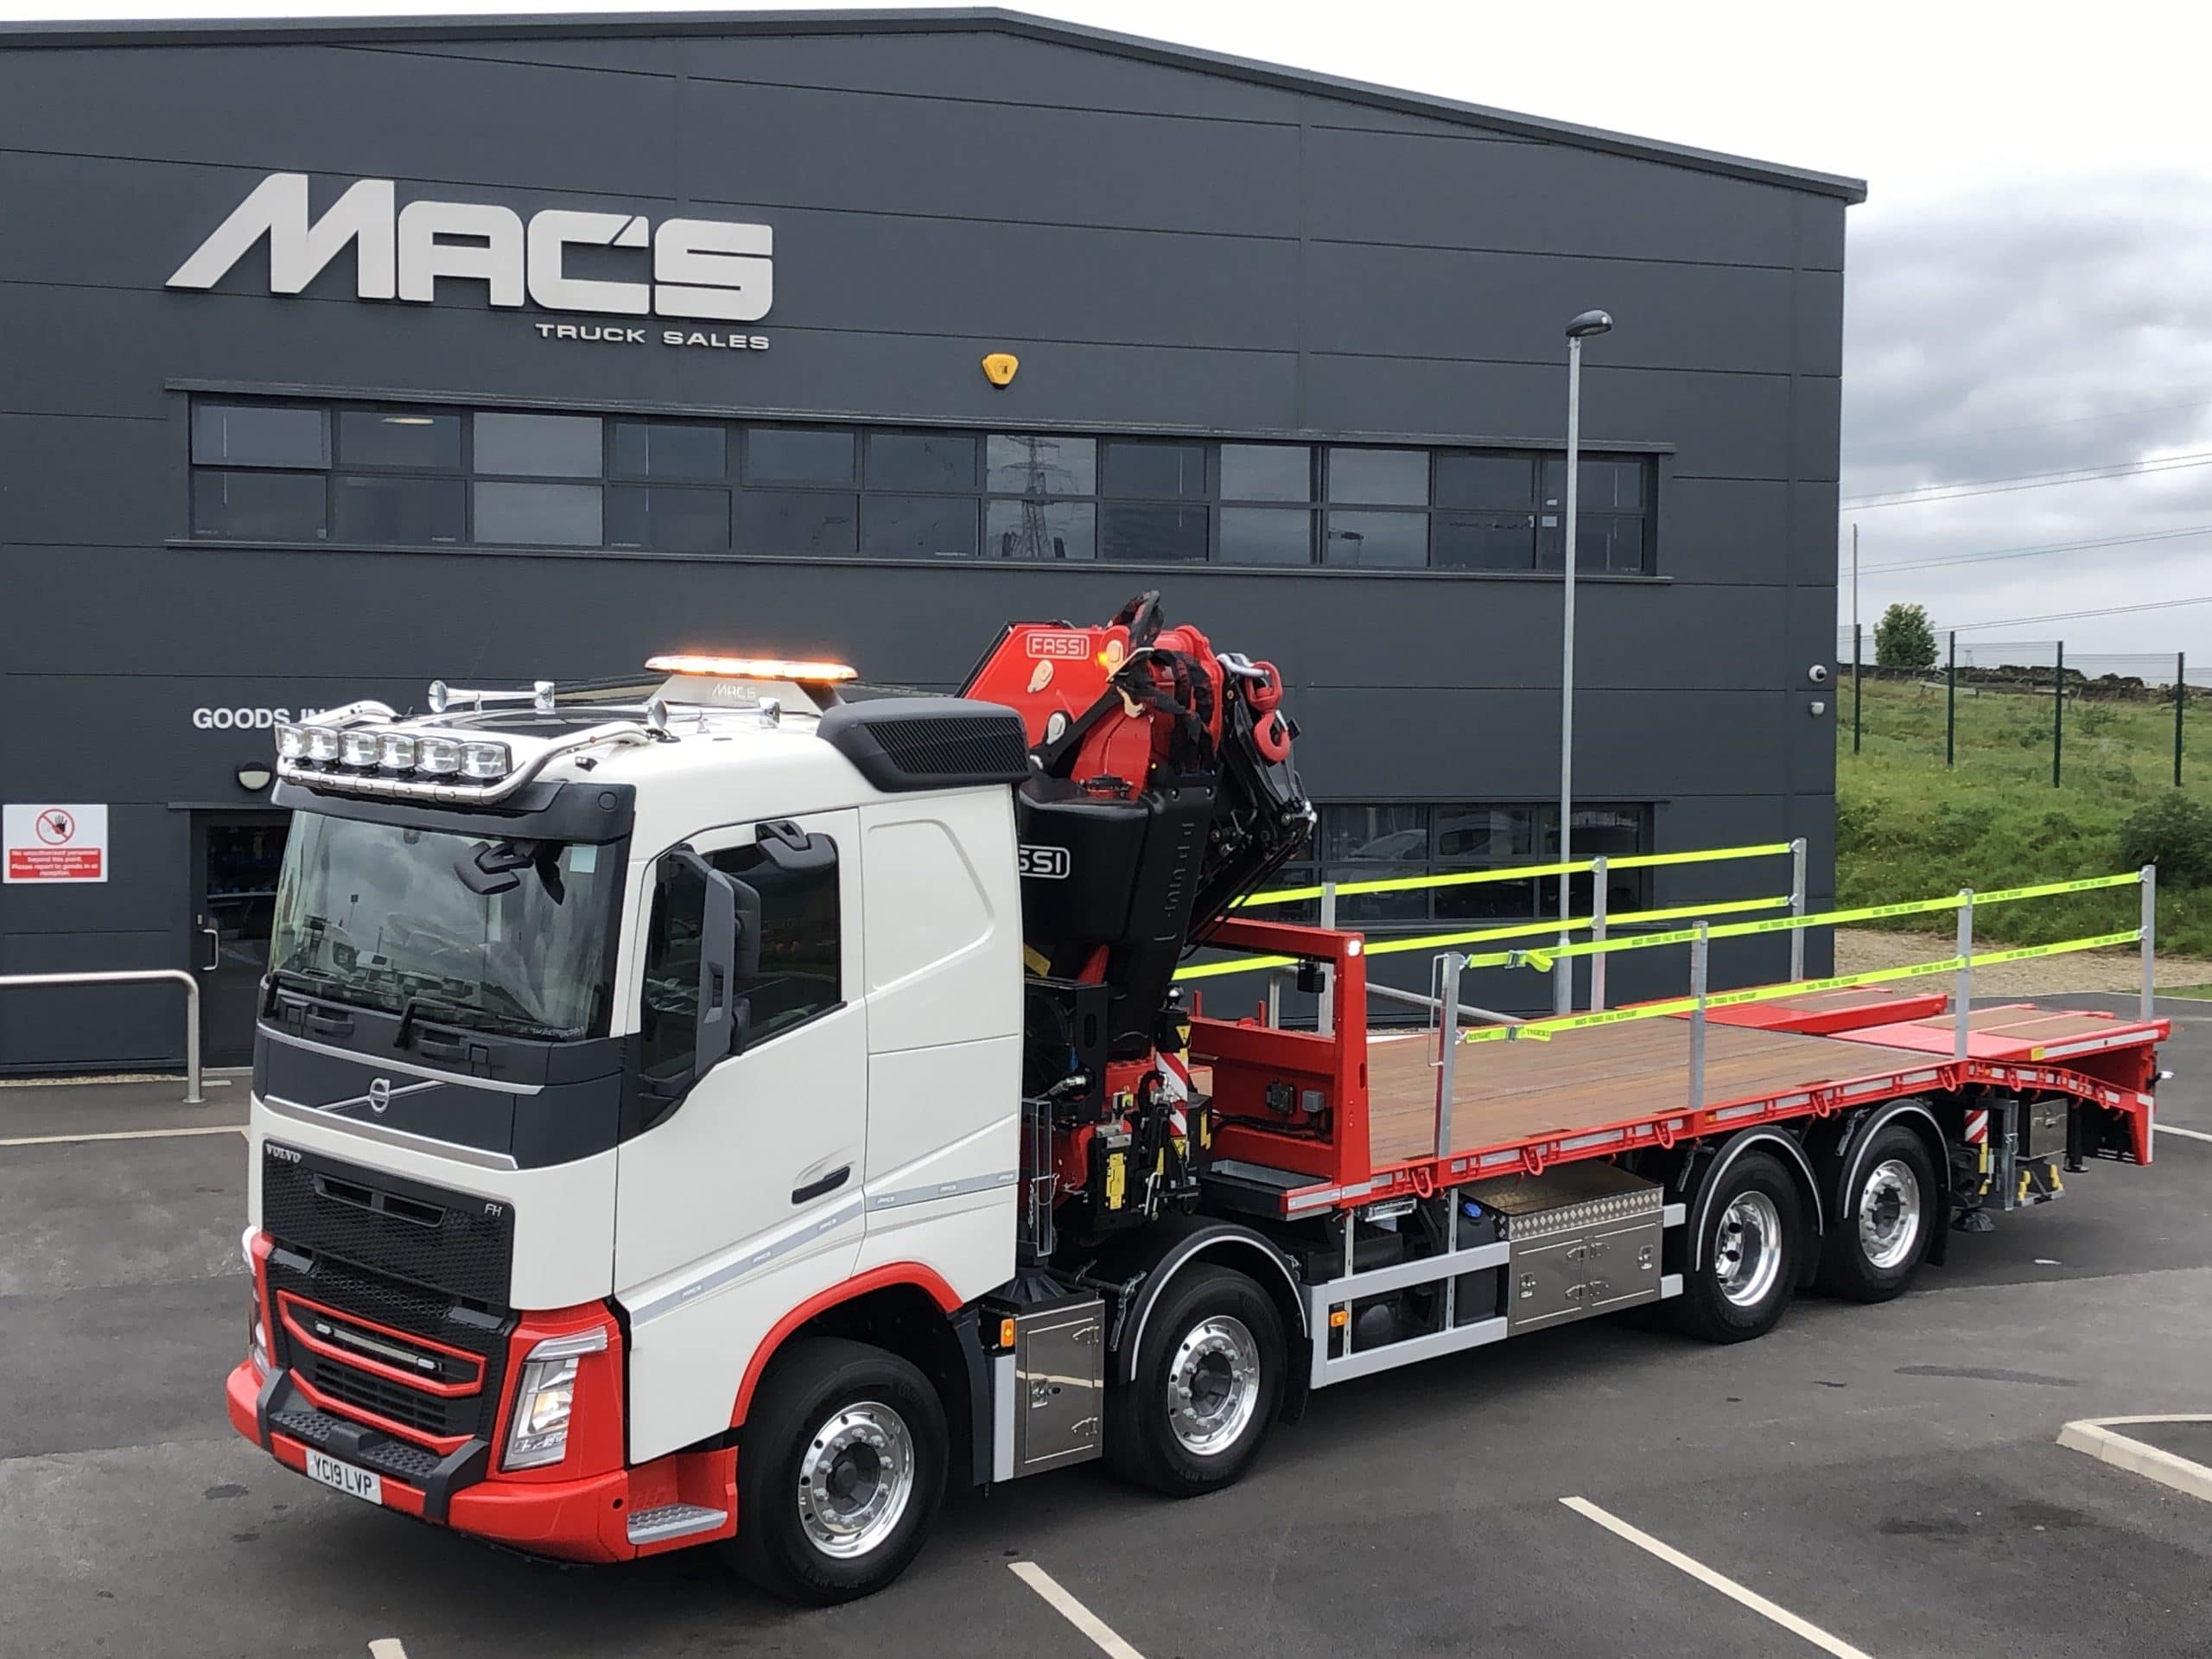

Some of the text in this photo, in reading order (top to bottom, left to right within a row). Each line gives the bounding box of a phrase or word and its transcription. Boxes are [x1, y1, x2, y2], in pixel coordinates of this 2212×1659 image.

[536, 323, 770, 350] TRUCK SALES
[1032, 638, 1084, 655] FASSI
[193, 708, 290, 728] GOODS
[265, 1143, 302, 1163] VOLVO
[484, 1203, 502, 1217] FH
[314, 1455, 372, 1495] YC19 LVP
